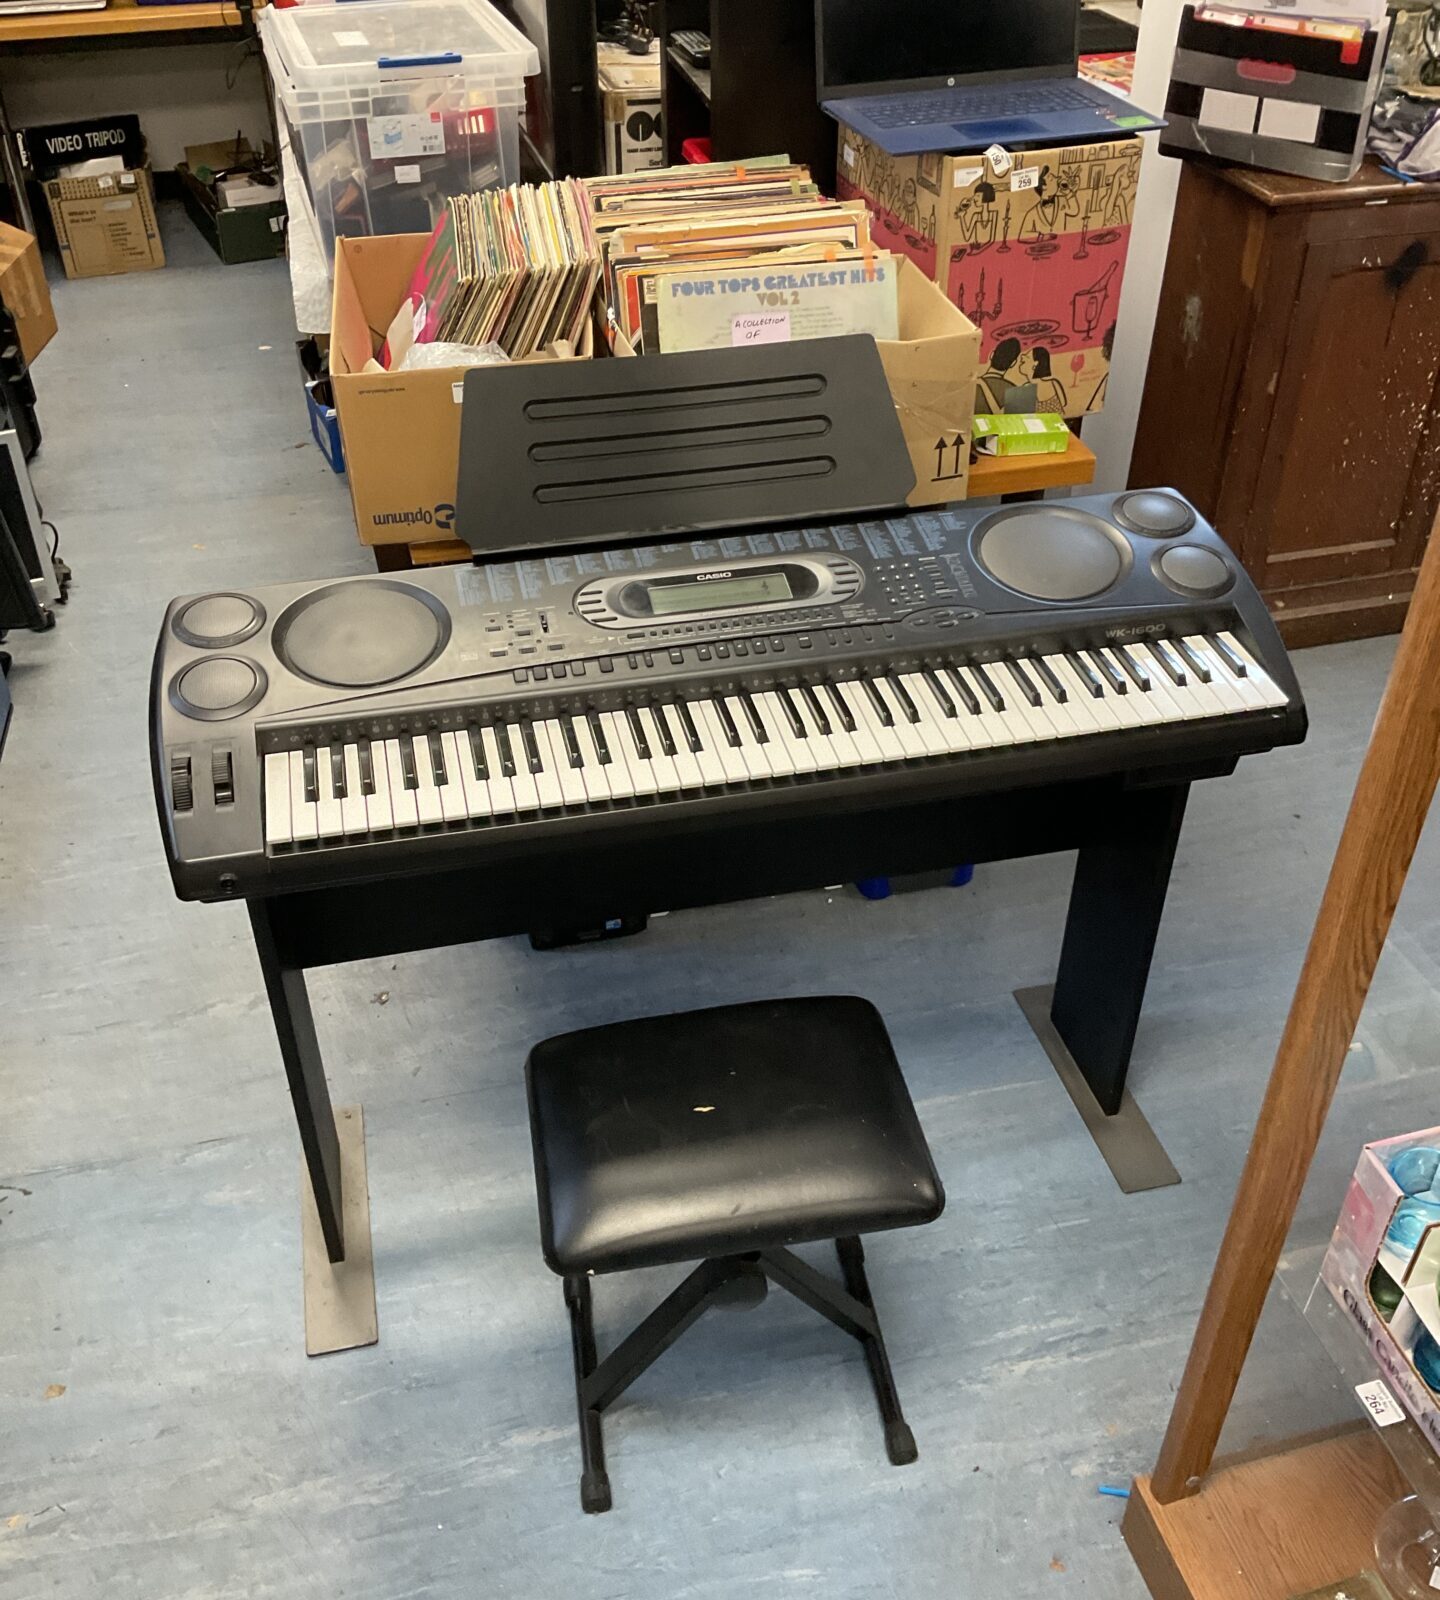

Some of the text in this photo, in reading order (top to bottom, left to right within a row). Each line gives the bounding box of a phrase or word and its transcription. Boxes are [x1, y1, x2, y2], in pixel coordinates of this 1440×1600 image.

[45, 134, 83, 154] VIDEO
[85, 128, 126, 149] TRIPOD
[1018, 178, 1032, 189] 259
[671, 280, 716, 298] FOUR
[717, 276, 761, 294] TOPS
[763, 270, 847, 291] GREATEST
[850, 267, 886, 284] HITS
[756, 290, 800, 307] VOL 2
[735, 315, 786, 328] A COLLECTION
[745, 330, 762, 339] OF
[372, 507, 433, 527] Optimum
[696, 571, 732, 581] CASIO
[1364, 1394, 1385, 1415] 264
